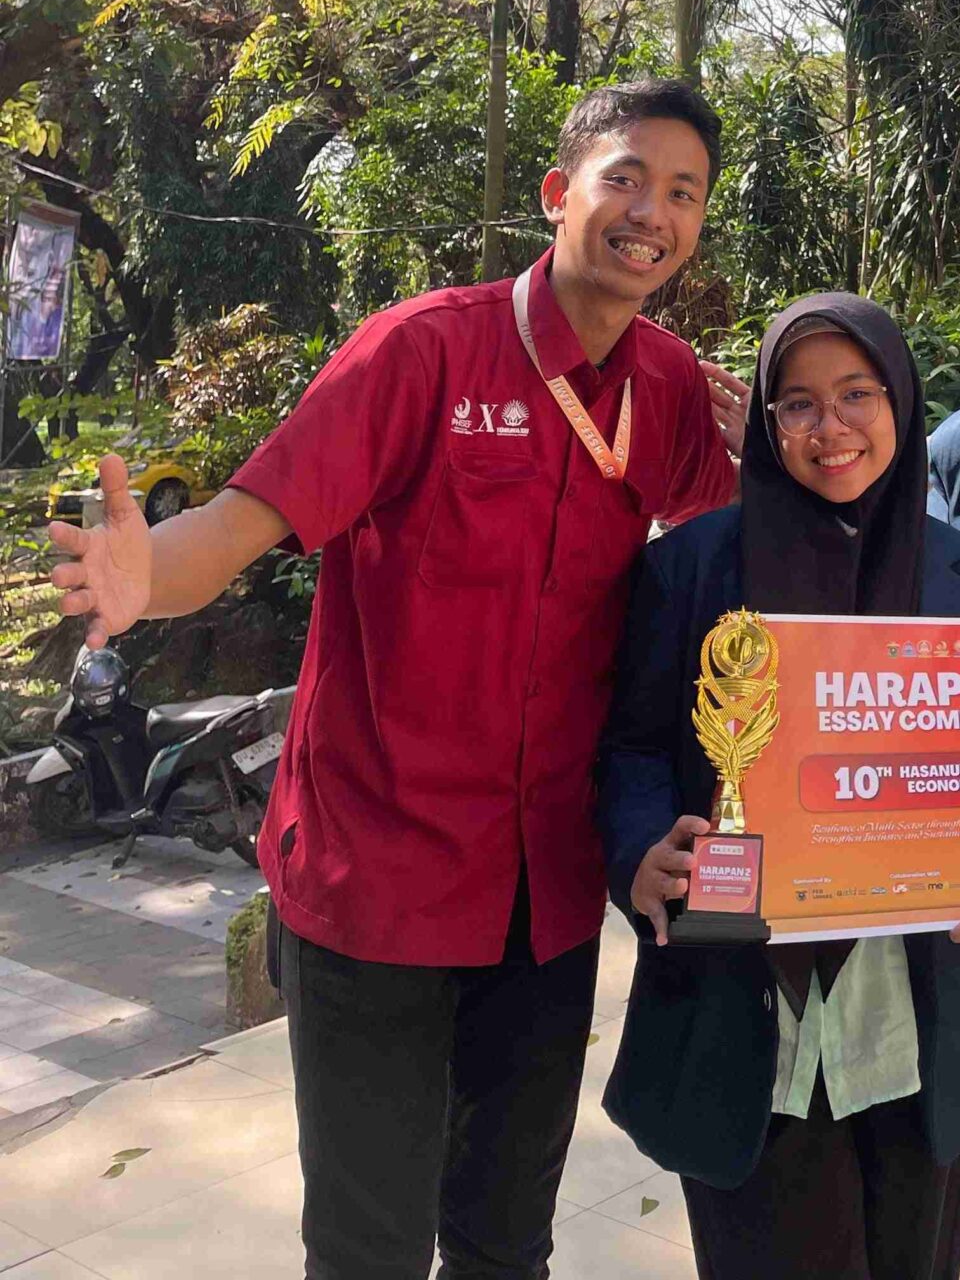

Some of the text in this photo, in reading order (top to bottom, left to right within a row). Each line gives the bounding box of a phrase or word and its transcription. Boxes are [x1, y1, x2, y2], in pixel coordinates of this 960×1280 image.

[473, 404, 499, 433] X
[818, 710, 895, 732] ESSAY
[699, 866, 752, 877] HARAPAN 2
